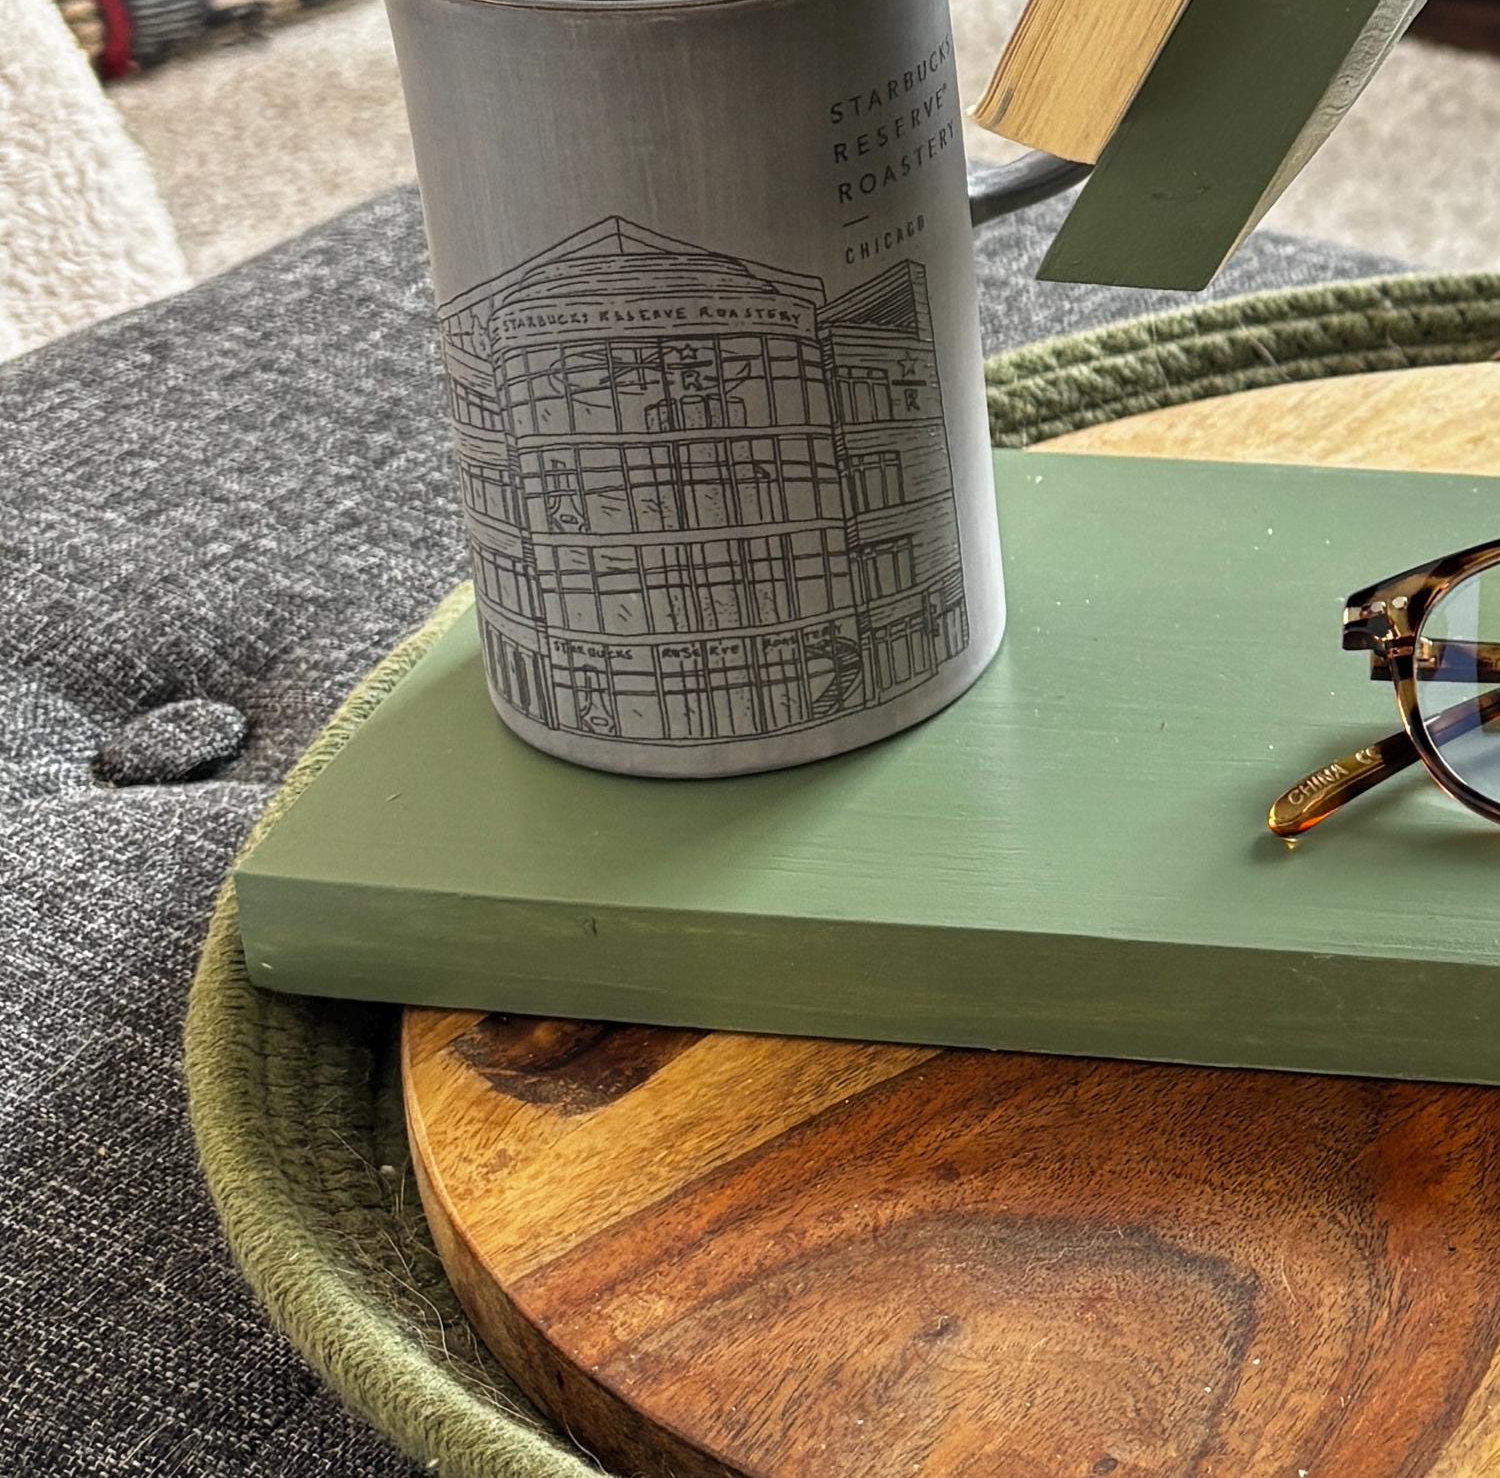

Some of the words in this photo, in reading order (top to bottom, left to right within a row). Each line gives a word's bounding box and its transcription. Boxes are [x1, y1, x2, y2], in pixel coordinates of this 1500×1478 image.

[838, 119, 956, 204] ROASTERY
[845, 214, 925, 264] CHICAGO
[699, 305, 802, 323] ROASTERY
[1287, 761, 1350, 806] CHINA
